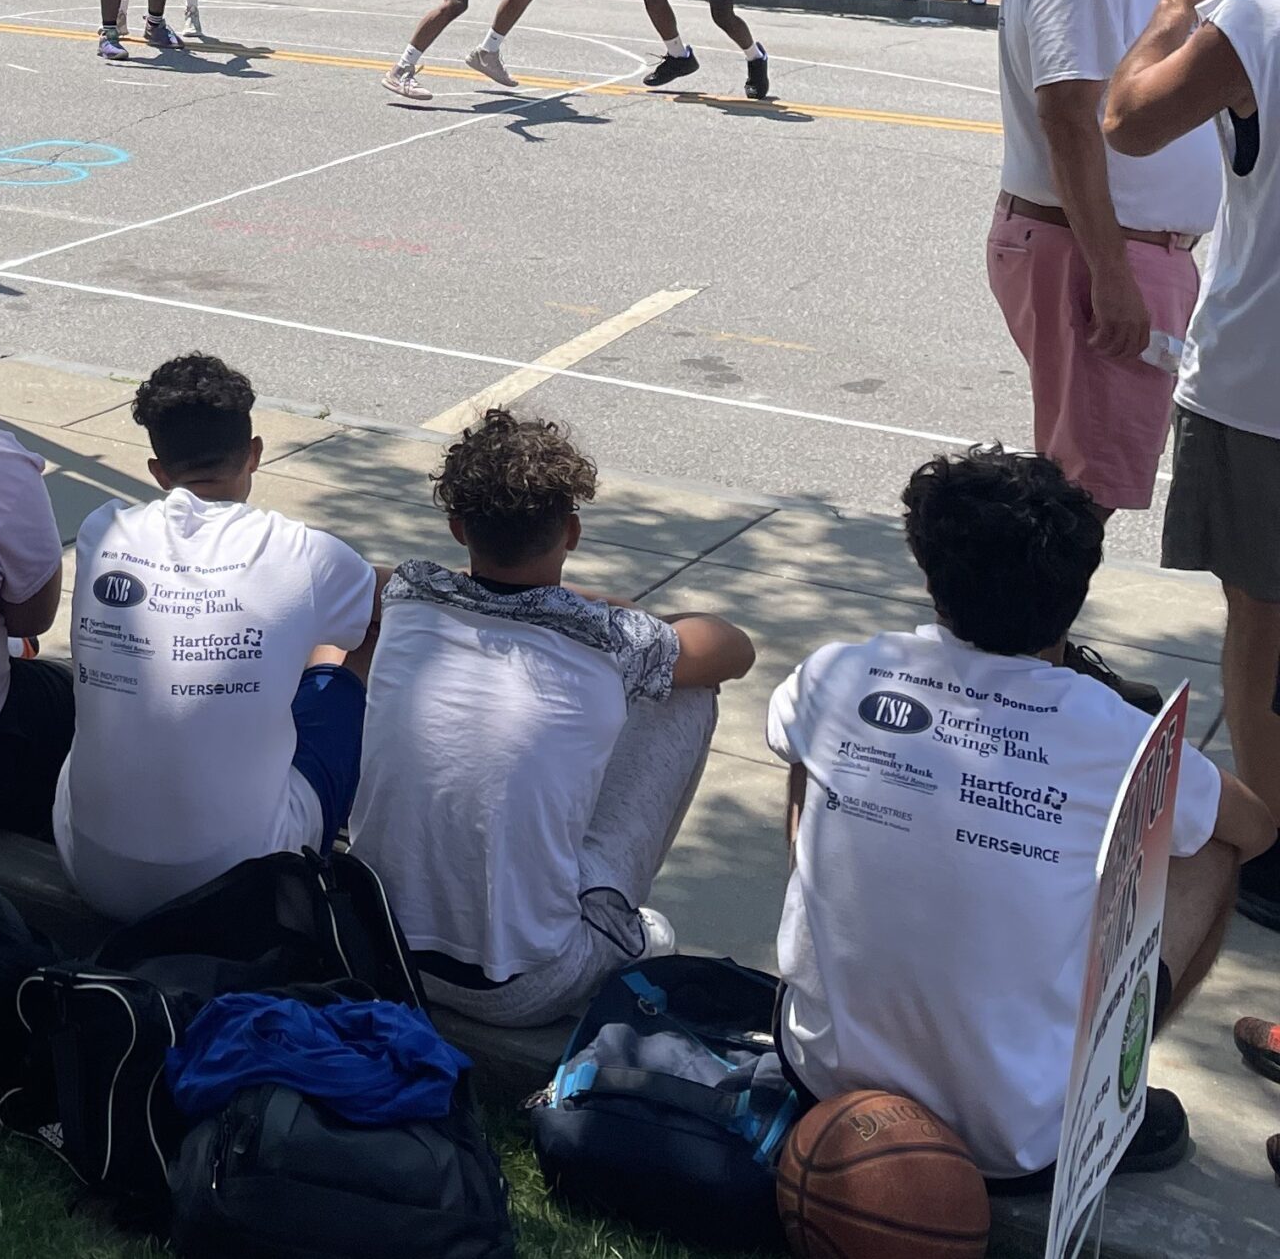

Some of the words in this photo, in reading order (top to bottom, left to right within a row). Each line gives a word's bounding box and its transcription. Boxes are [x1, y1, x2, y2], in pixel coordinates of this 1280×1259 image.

[101, 550, 118, 560] With
[120, 552, 157, 569] Thanks
[159, 563, 171, 572] to
[173, 563, 191, 574] Our
[194, 561, 247, 575] Sponsors
[104, 575, 132, 603] TSB
[151, 582, 226, 603] Torrington
[147, 598, 202, 619] Savings
[205, 597, 245, 615] Bank
[128, 633, 152, 645] Bank
[172, 633, 241, 648] Hartford
[171, 647, 263, 662] HealthCare
[171, 681, 261, 696] EVERSOURCE
[869, 667, 894, 679] With
[897, 671, 943, 690] Thanks
[948, 682, 960, 694] to
[965, 687, 989, 701] Our
[993, 692, 1058, 713] Sponsors
[874, 695, 913, 729] TSB
[938, 709, 1030, 742] Torrington
[852, 742, 897, 759] Northwest
[932, 726, 998, 757] Savings
[1004, 739, 1050, 765] Bank
[850, 751, 904, 772] Community
[905, 763, 934, 779] Bank
[1147, 714, 1178, 830] OF
[960, 772, 1042, 803] Hartford
[861, 800, 913, 822] INDUSTRIES
[959, 787, 1063, 824] HealthCare
[955, 828, 1060, 863] EVERSOURCE
